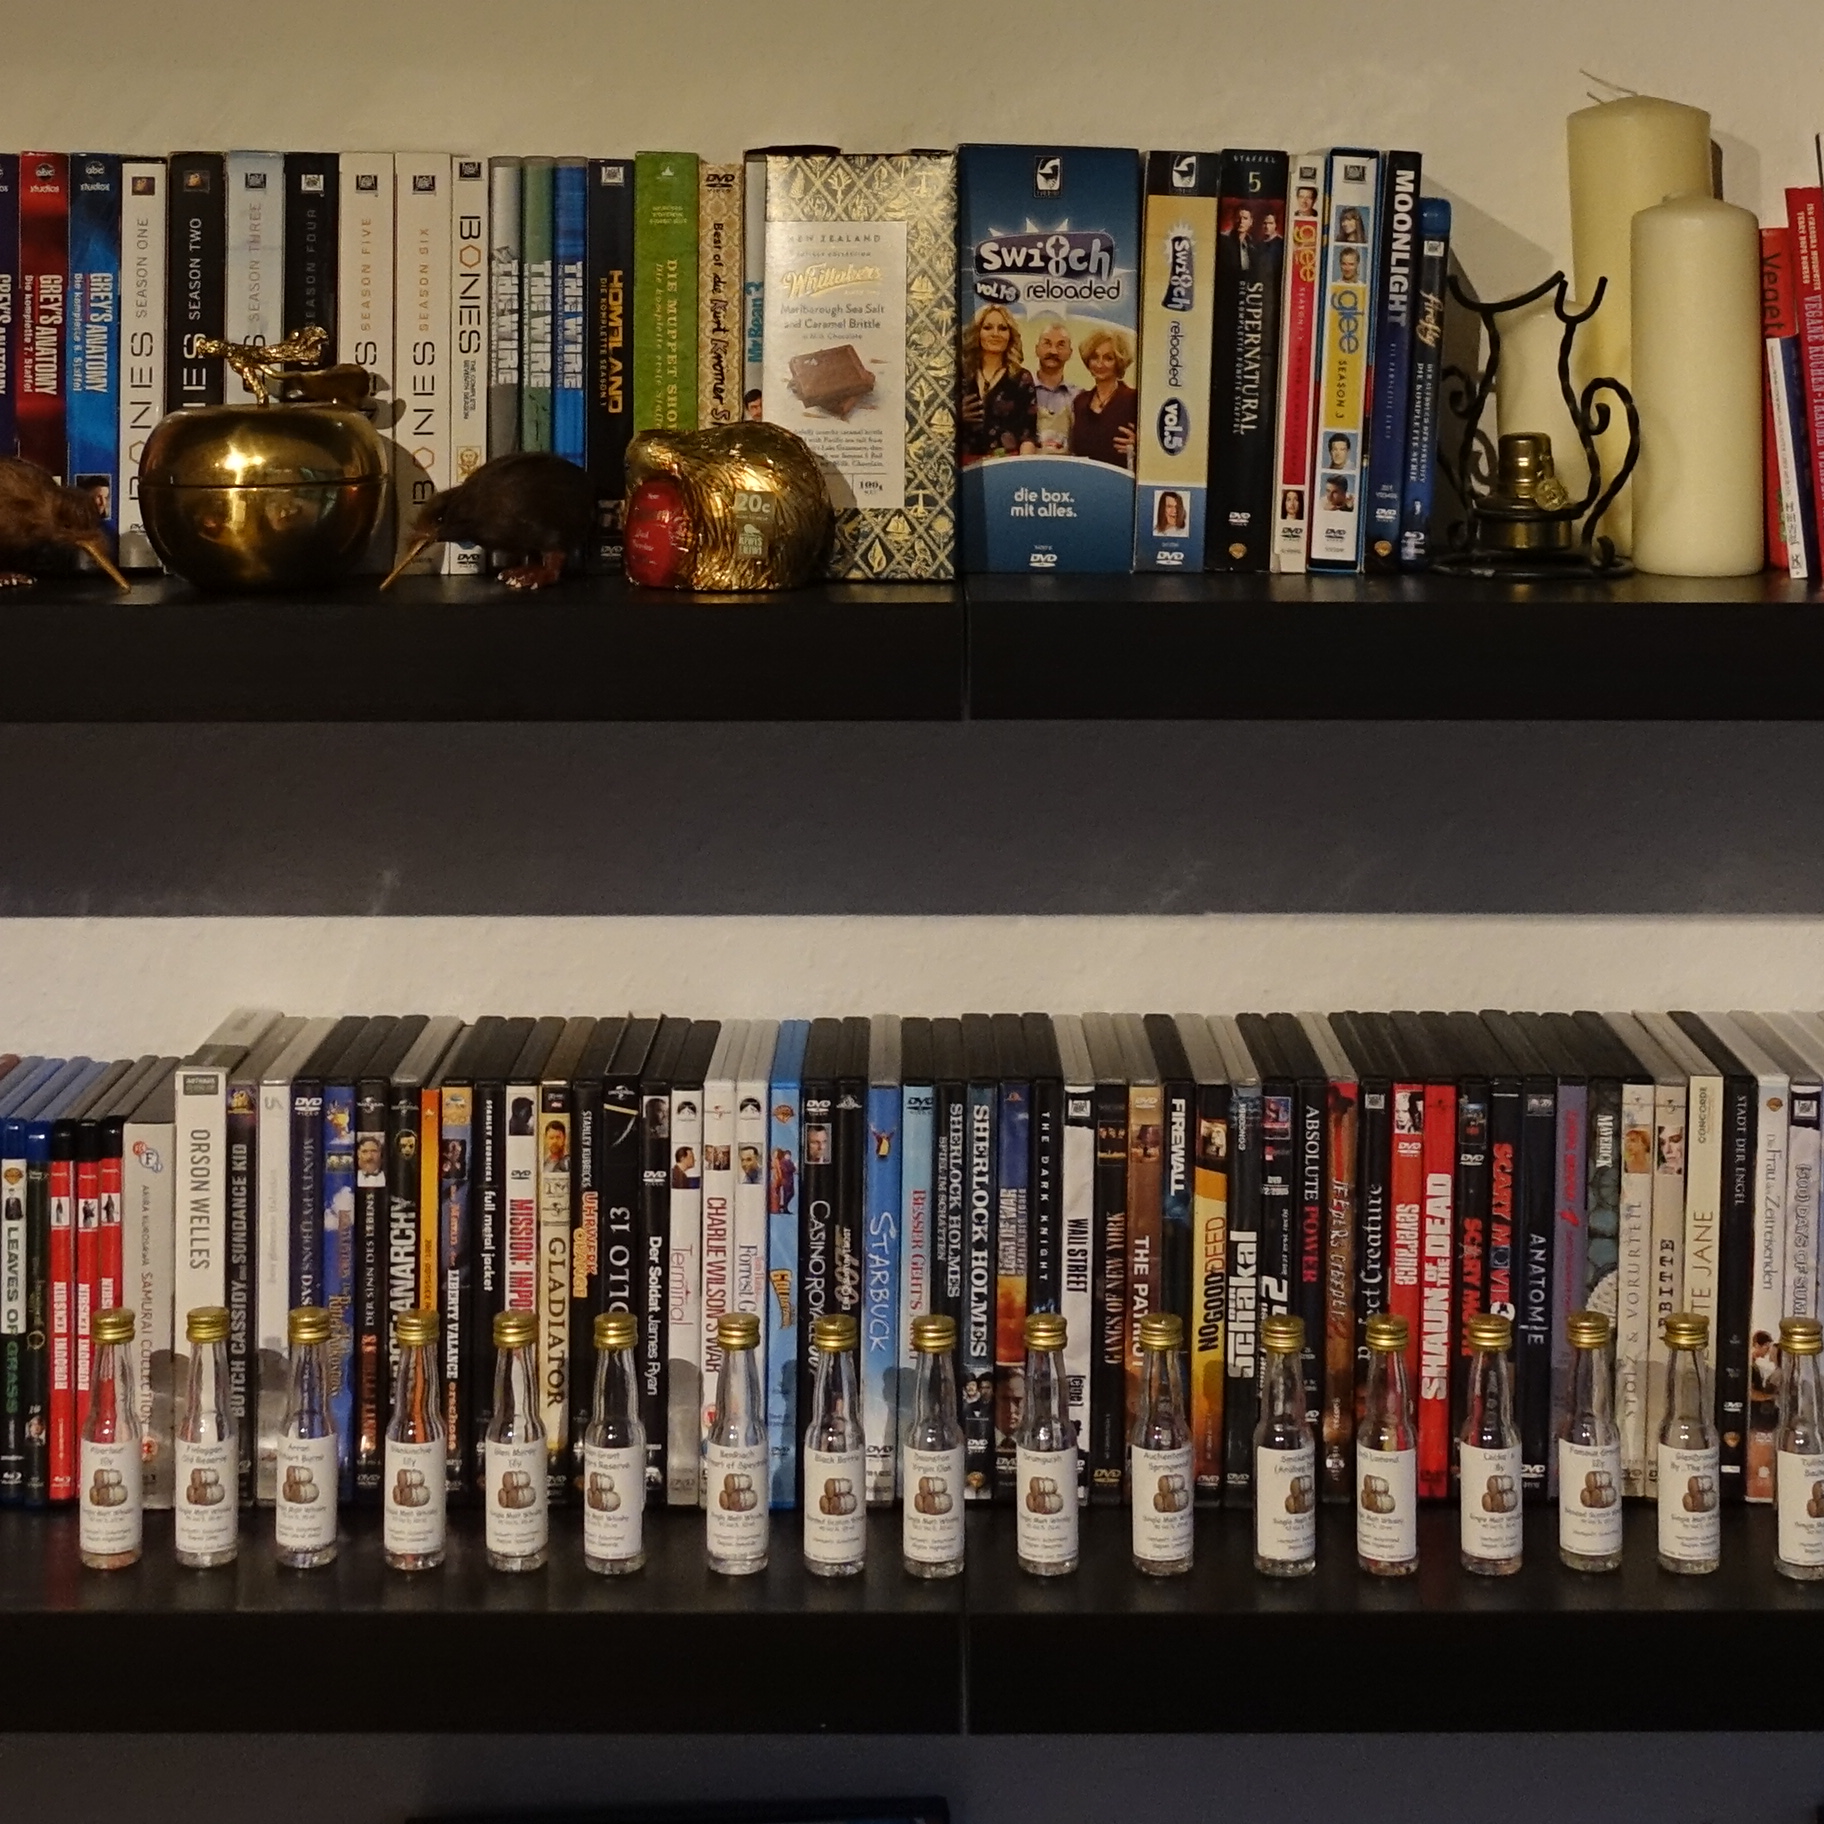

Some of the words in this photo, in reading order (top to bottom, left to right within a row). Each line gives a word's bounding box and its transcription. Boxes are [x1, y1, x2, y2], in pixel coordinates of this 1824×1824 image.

[1249, 172, 1261, 193] 5
[1388, 170, 1414, 327] MOONLIGHT
[86, 272, 113, 324] GREY'S
[459, 216, 481, 355] BONES
[781, 305, 844, 317] Marlborough
[847, 304, 859, 314] Sea
[862, 303, 886, 314] Salt
[1027, 281, 1120, 300] reloaded
[607, 269, 625, 415] HOMELAND
[784, 320, 803, 329] and
[806, 318, 844, 329] Caramel
[847, 317, 881, 328] Brittle
[1331, 290, 1358, 354] glee
[86, 325, 113, 394] ANATOMY
[1245, 280, 1264, 432] SUPERNATURAL
[735, 493, 771, 512] 20c
[1010, 503, 1032, 518] mit
[1037, 503, 1076, 519] alles.
[1015, 489, 1036, 503] die
[1040, 489, 1074, 503] box.
[190, 1129, 212, 1194] ORSON
[230, 1142, 248, 1171] KID
[972, 1103, 990, 1243] SHERLOCK
[1169, 1098, 1187, 1195] FIREWALL
[1303, 1103, 1320, 1200] ABSOLUTE
[190, 1200, 212, 1271] WELLES
[230, 1175, 249, 1262] SUNDANCE
[1425, 1174, 1452, 1254] DEAD
[5, 1226, 20, 1302] LEAVES
[648, 1235, 663, 1262] Der
[1422, 1260, 1438, 1286] OF
[1437, 1255, 1451, 1287] THE
[648, 1266, 663, 1313] Soldat
[868, 1212, 895, 1353] STARBUCK
[969, 1247, 988, 1358] HOLMES
[1228, 1230, 1258, 1379] Schakal
[547, 1237, 566, 1408] GLADIATOR
[648, 1317, 661, 1358] James
[1421, 1288, 1452, 1400] SHAUN
[647, 1362, 659, 1396] Ryan
